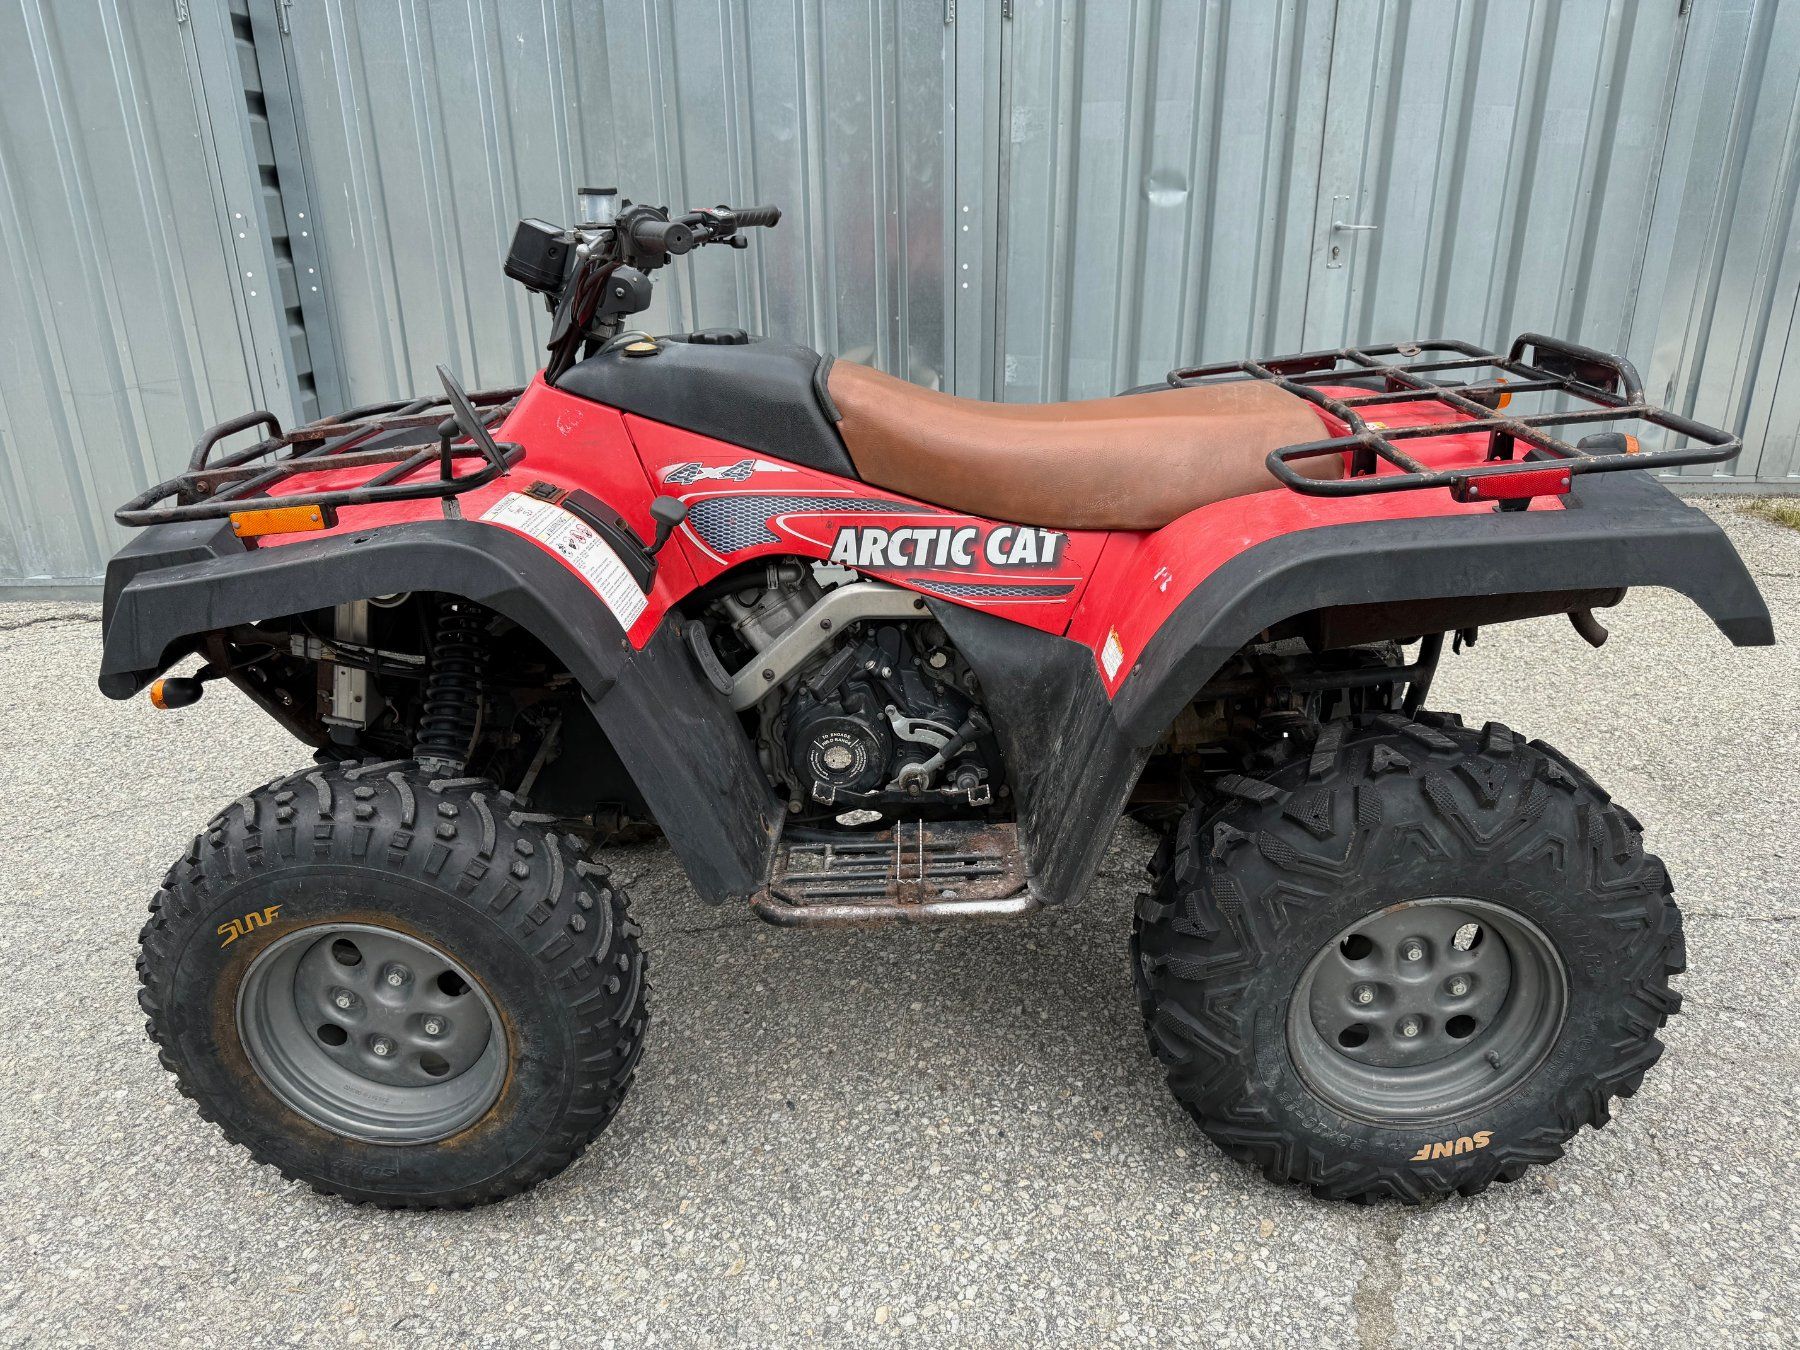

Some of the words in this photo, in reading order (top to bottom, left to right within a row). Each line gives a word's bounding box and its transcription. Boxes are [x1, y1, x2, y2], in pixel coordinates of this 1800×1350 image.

[663, 459, 757, 486] 4x4
[829, 527, 978, 567] ARCTIC
[985, 526, 1064, 566] CAT
[217, 904, 284, 949] SUNF
[1408, 1130, 1496, 1162] SUNF
